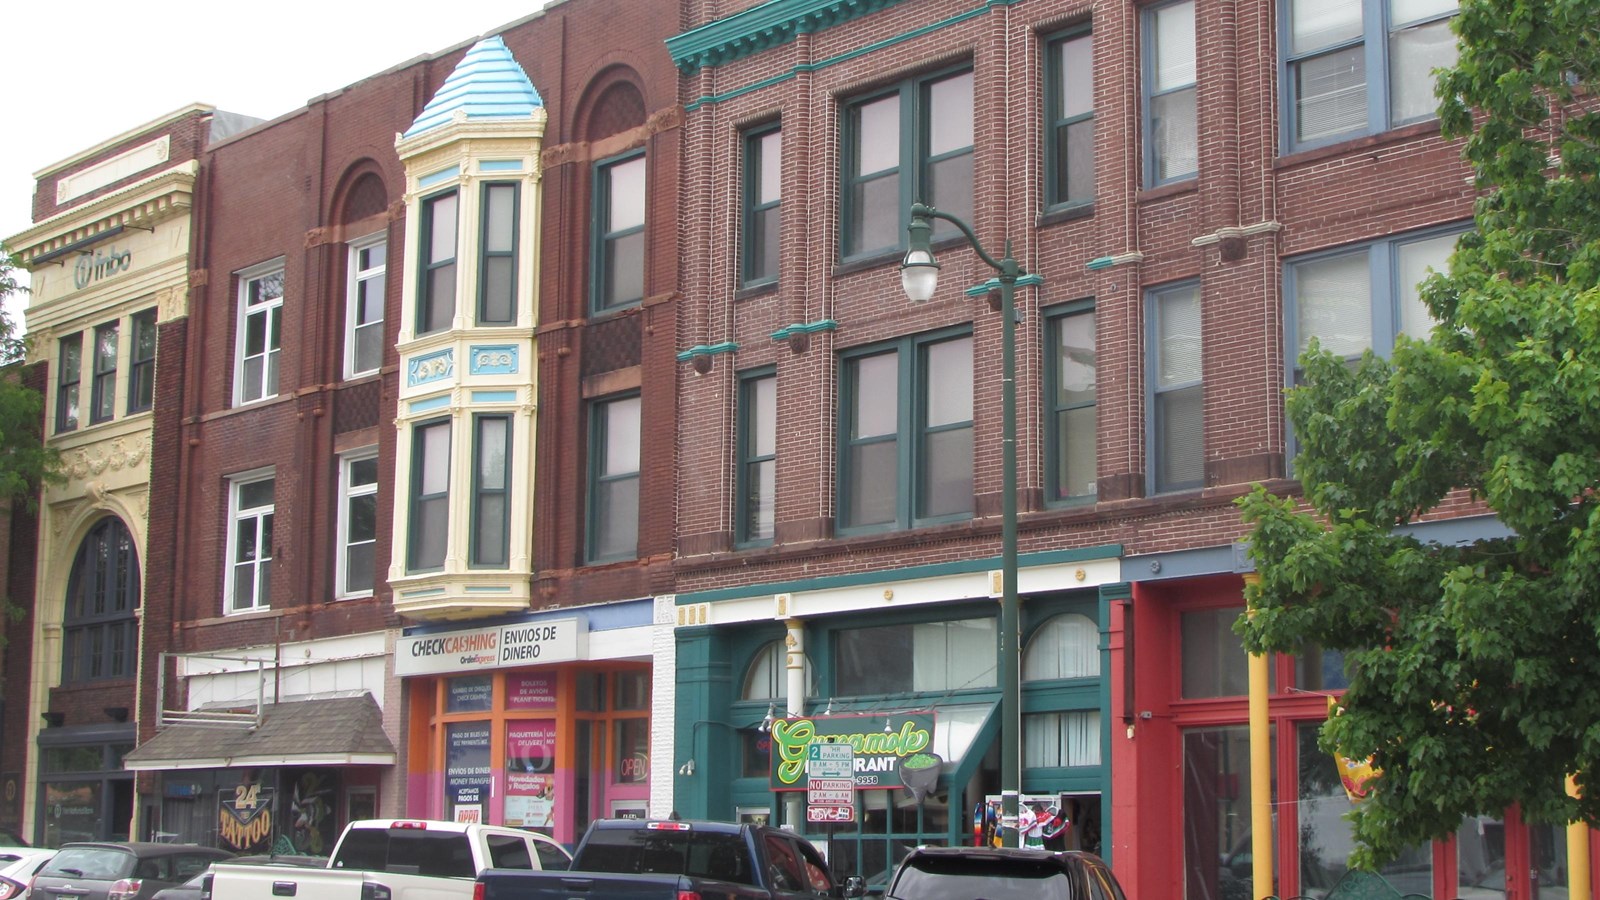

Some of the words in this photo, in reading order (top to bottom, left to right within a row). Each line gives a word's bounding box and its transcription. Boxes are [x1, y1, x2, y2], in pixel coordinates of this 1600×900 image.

[504, 628, 541, 645] ENVIOS
[543, 626, 557, 641] DE
[503, 644, 541, 661] DINERO
[811, 746, 818, 758] 2
[467, 767, 474, 775] DE
[475, 766, 491, 774] DINER
[621, 758, 646, 776] OPEN
[450, 777, 468, 785] MONEY
[810, 780, 821, 790] NO
[220, 809, 270, 849] TATTOO
